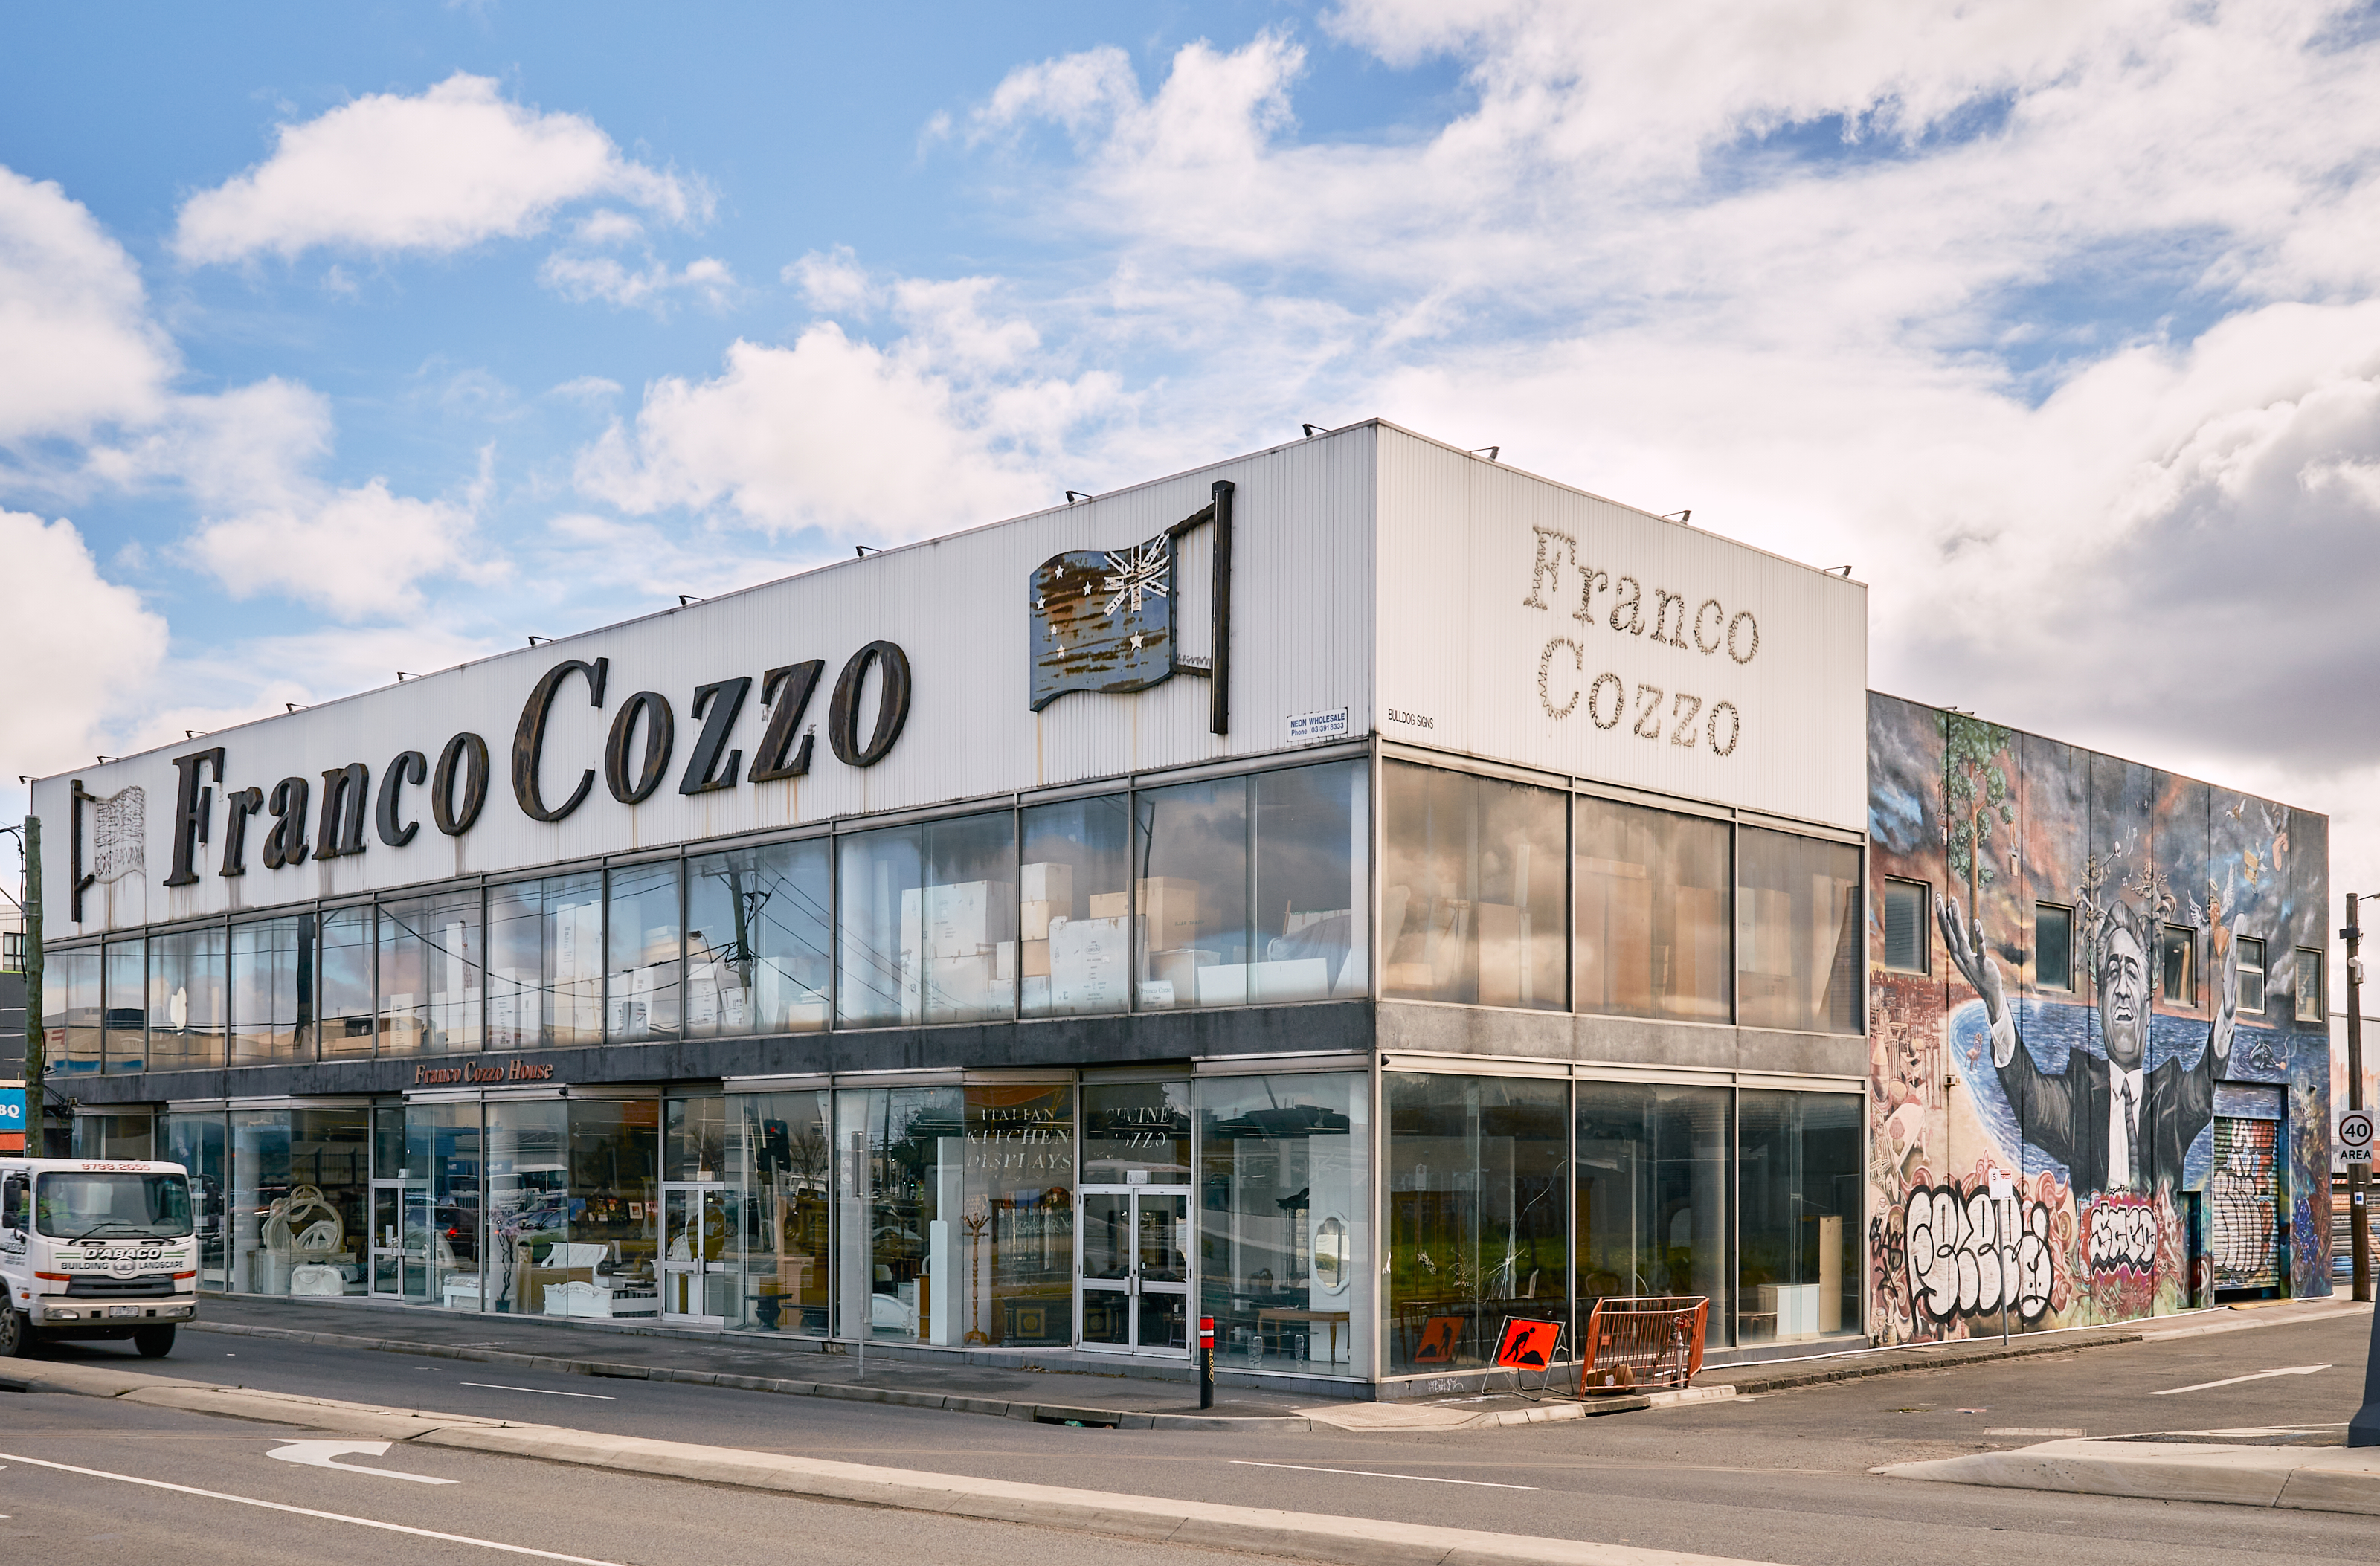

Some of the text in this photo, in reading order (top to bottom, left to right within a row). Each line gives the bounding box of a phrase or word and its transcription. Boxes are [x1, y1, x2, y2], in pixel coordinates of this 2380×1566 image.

[1523, 526, 1759, 664] Franco
[1538, 637, 1740, 757] Cozzo
[1290, 713, 1345, 728] NEON WHOLESALE
[1388, 709, 1433, 729] BULLDOG SIGNS
[163, 732, 489, 886] Franco
[512, 640, 911, 822] Cozzo
[414, 1059, 553, 1084] Franco Cozzo House
[2344, 1124, 2367, 1137] 40
[2340, 1150, 2371, 1159] AREA
[81, 1163, 150, 1171] 9798.2655
[84, 1248, 162, 1260] D'ABACO
